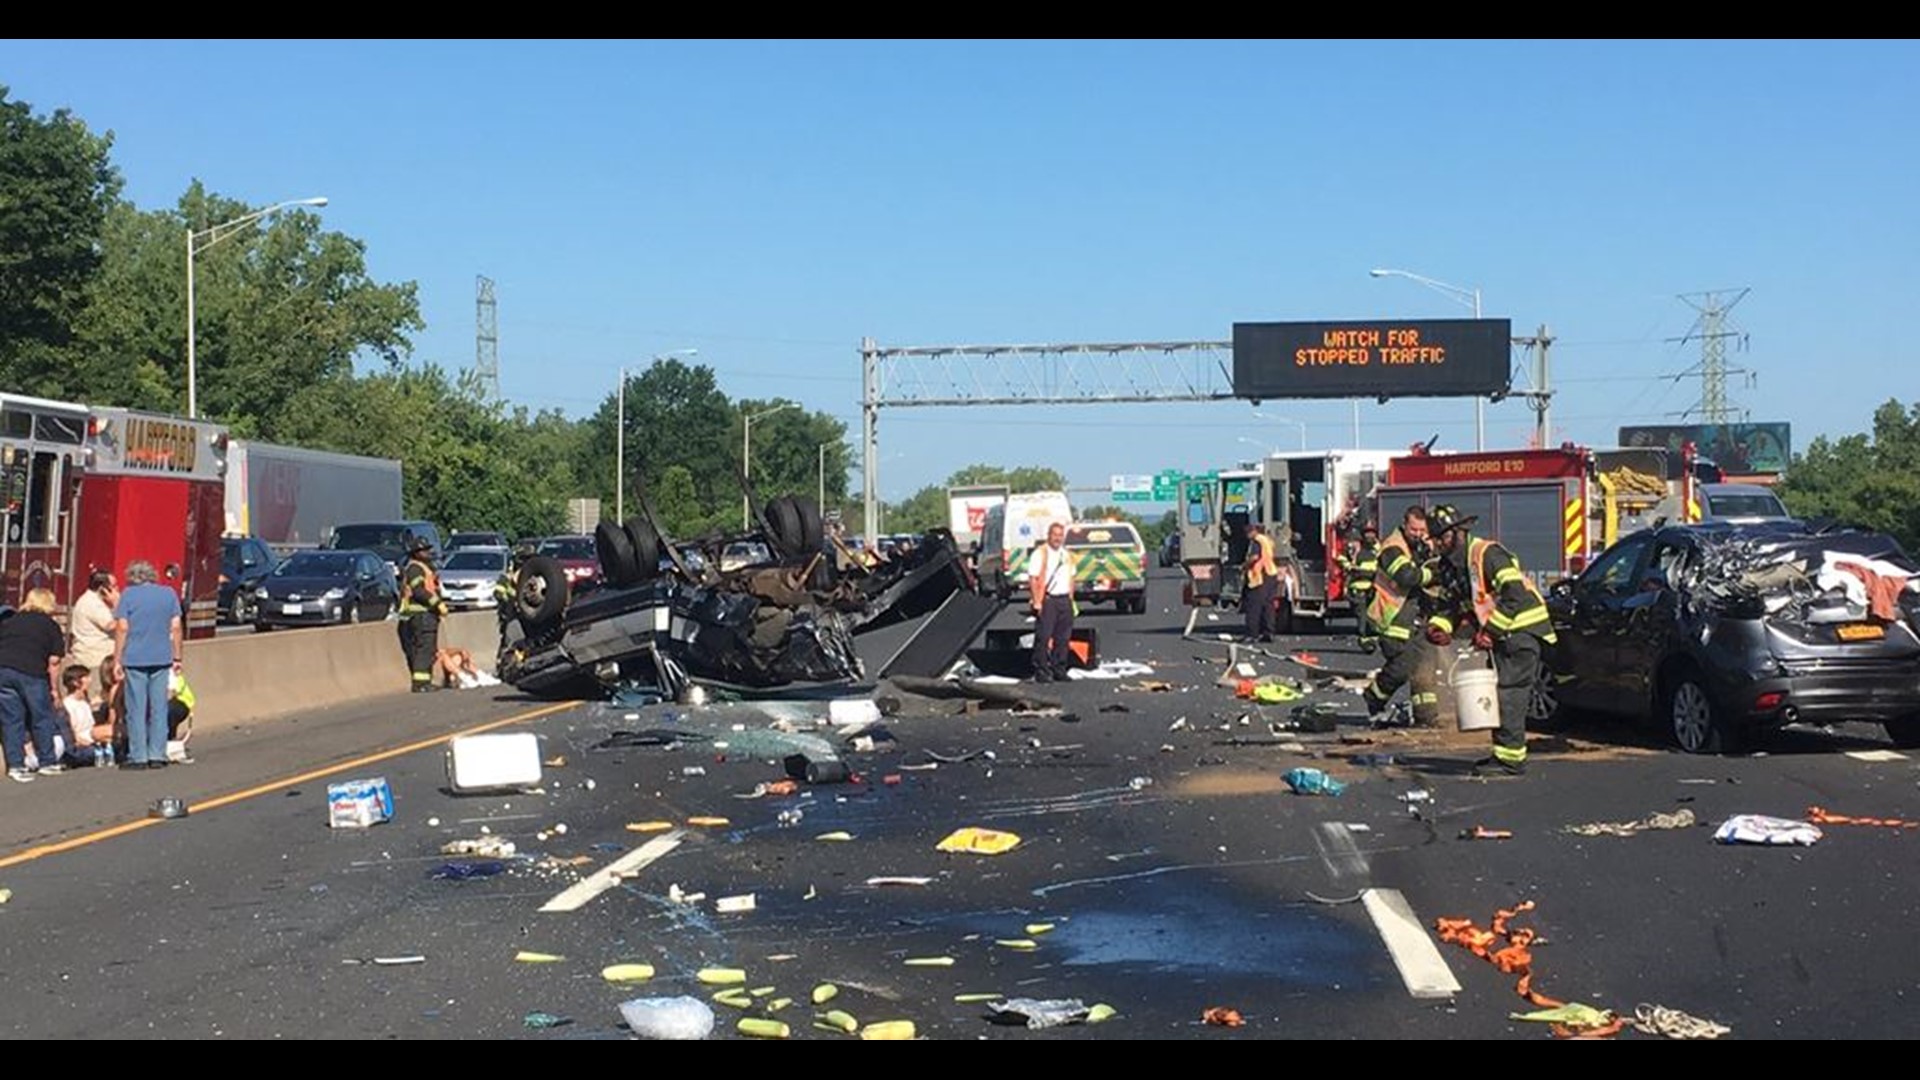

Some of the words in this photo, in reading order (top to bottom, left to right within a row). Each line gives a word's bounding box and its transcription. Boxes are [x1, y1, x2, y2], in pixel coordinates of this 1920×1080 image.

[1324, 330, 1379, 347] WATCH
[1388, 329, 1418, 346] FOR
[1296, 349, 1369, 365] STOPPED
[1379, 348, 1445, 364] TRAFFIC
[124, 418, 196, 472] HARTFORD
[1444, 461, 1501, 475] HARTFORD
